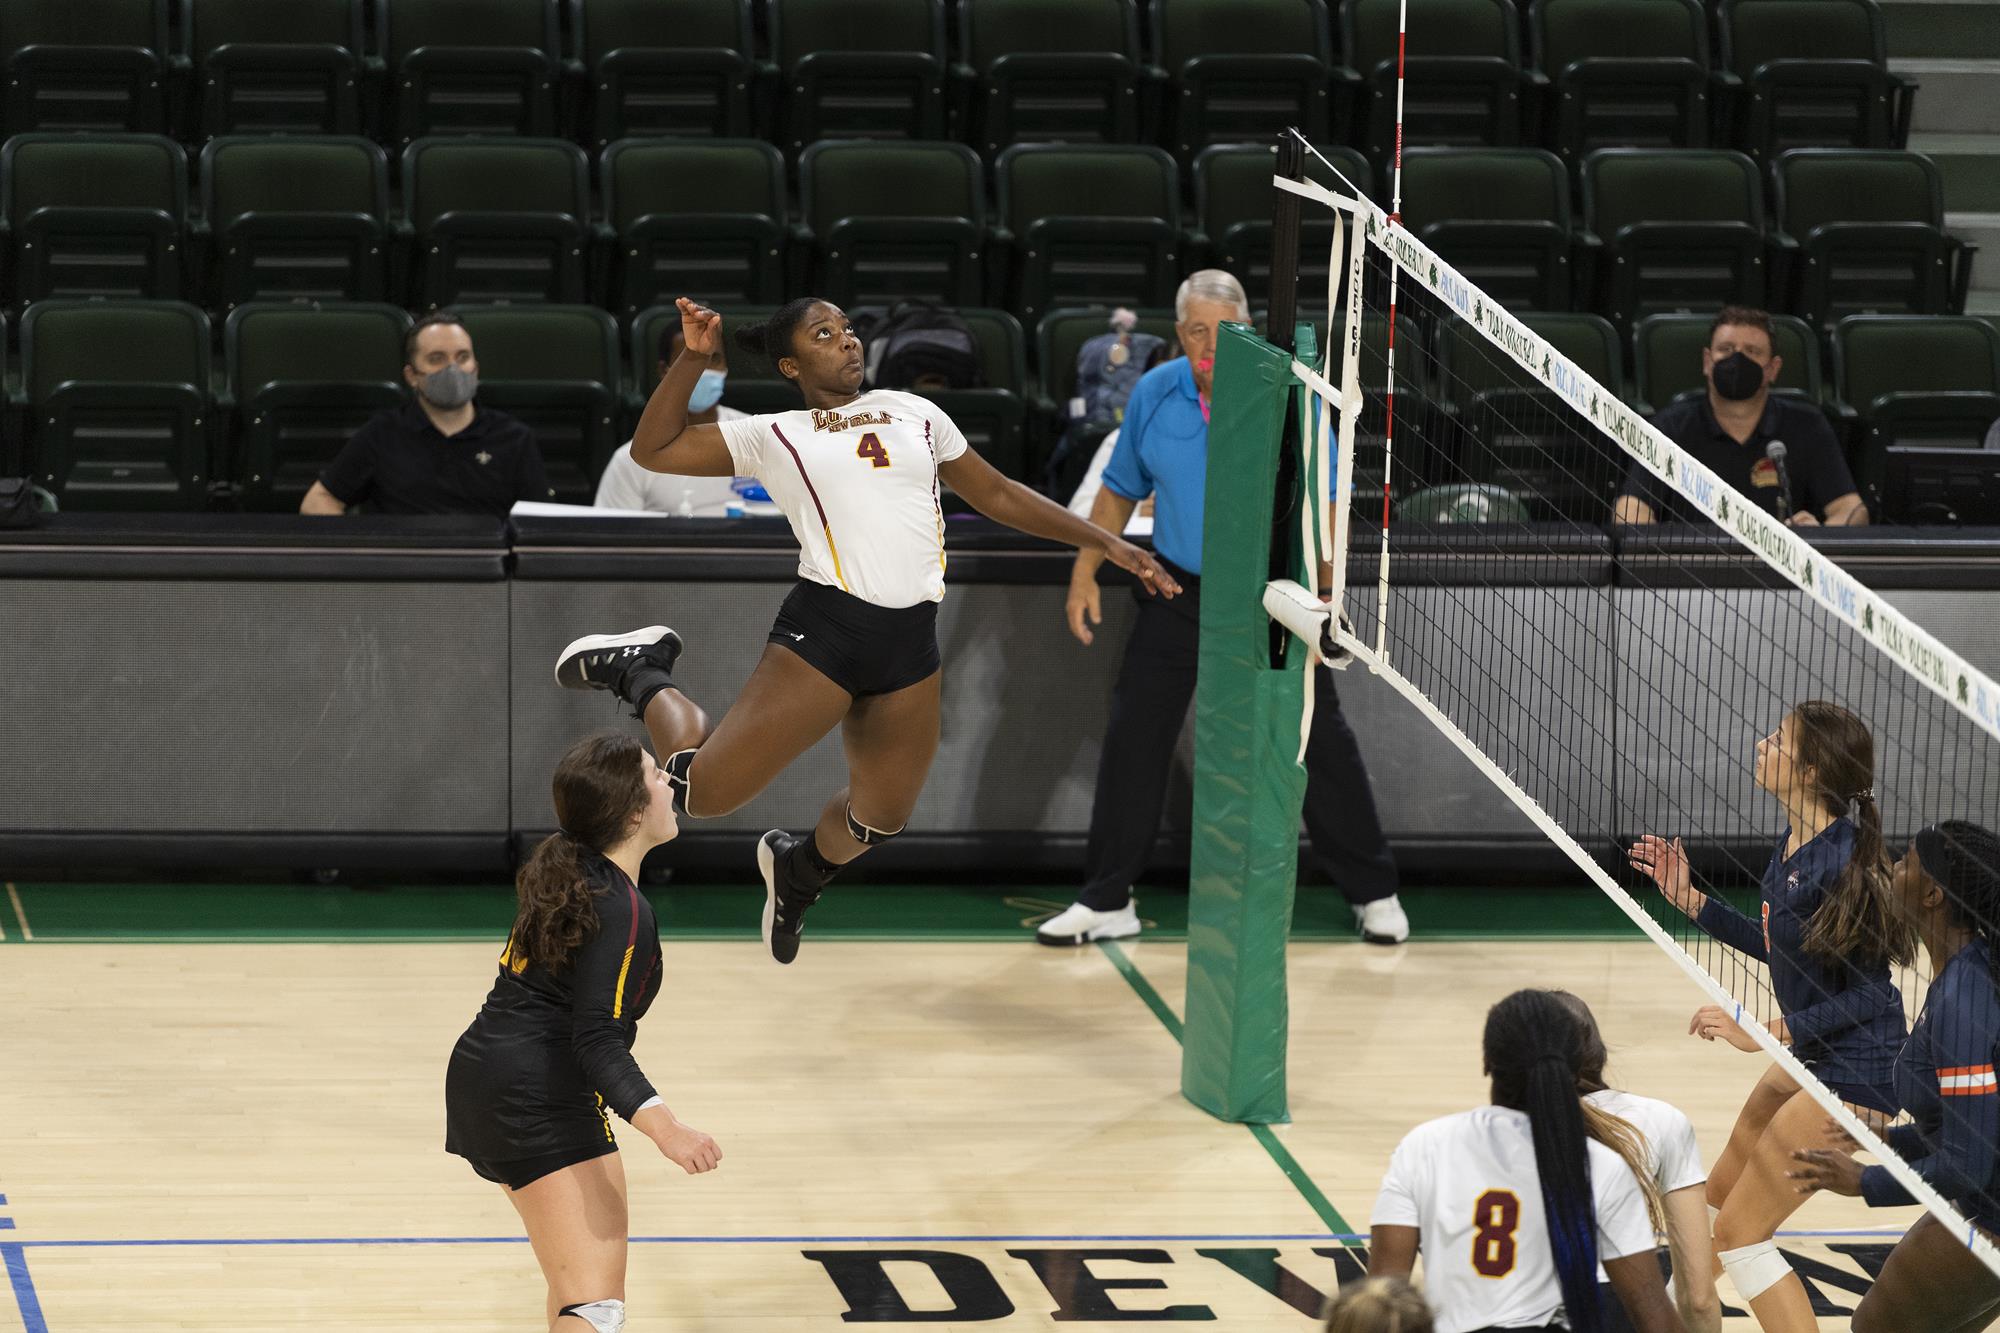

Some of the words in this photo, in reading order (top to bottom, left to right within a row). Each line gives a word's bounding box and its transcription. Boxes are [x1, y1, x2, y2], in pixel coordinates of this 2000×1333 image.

[828, 421, 849, 433] NEW
[857, 432, 891, 468] 4
[1472, 1187, 1520, 1279] 8
